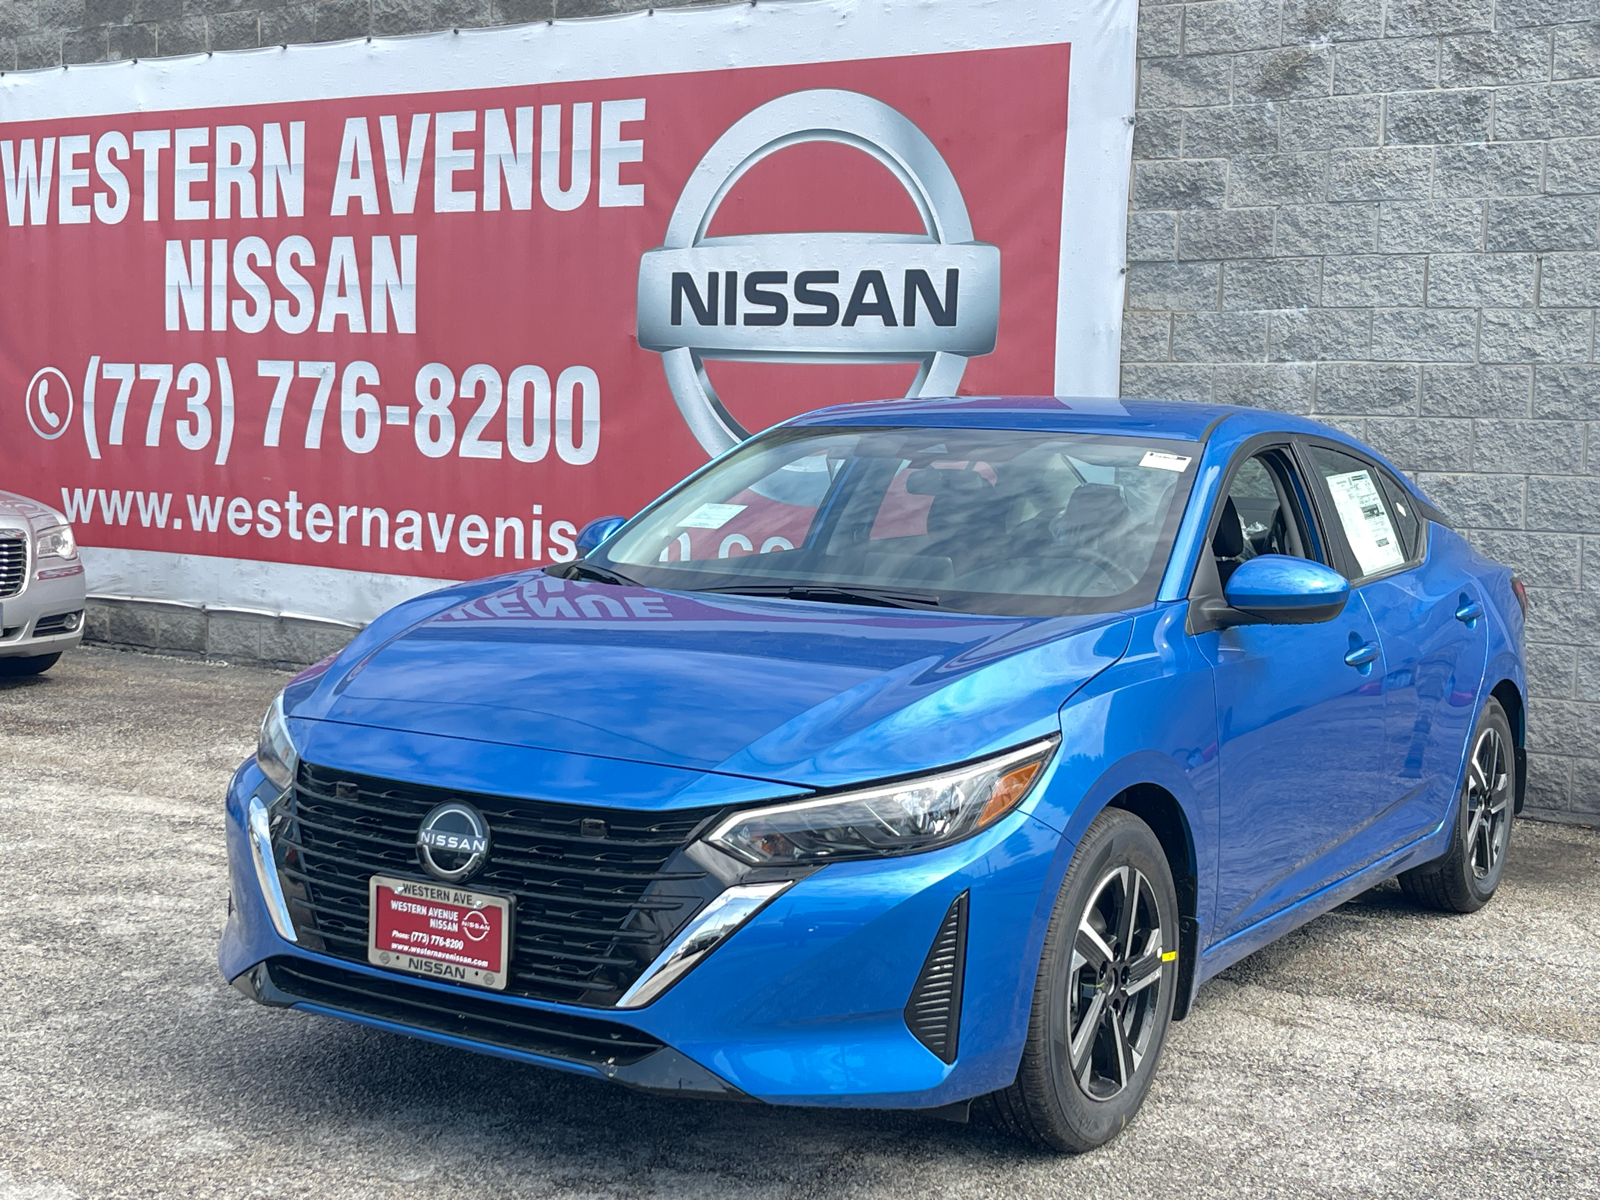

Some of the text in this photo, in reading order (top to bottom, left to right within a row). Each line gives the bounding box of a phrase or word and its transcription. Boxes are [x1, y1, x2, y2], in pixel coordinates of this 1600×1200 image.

[0, 98, 647, 226] WESTERN AVENUE
[165, 235, 418, 334] NISSAN
[670, 268, 960, 327] NISSAN
[82, 355, 601, 466] (773) 776-8200
[420, 831, 486, 851] NISSAN
[402, 883, 450, 902] WESTERN
[390, 900, 459, 921] WESTERN AVENUE
[430, 917, 459, 933] NISSAN
[461, 921, 490, 931] NISSAN
[411, 931, 430, 946] (773)
[430, 934, 464, 950] 776-8200
[390, 942, 489, 968] www.westernavenissan.com
[408, 957, 466, 980] NISSAN
